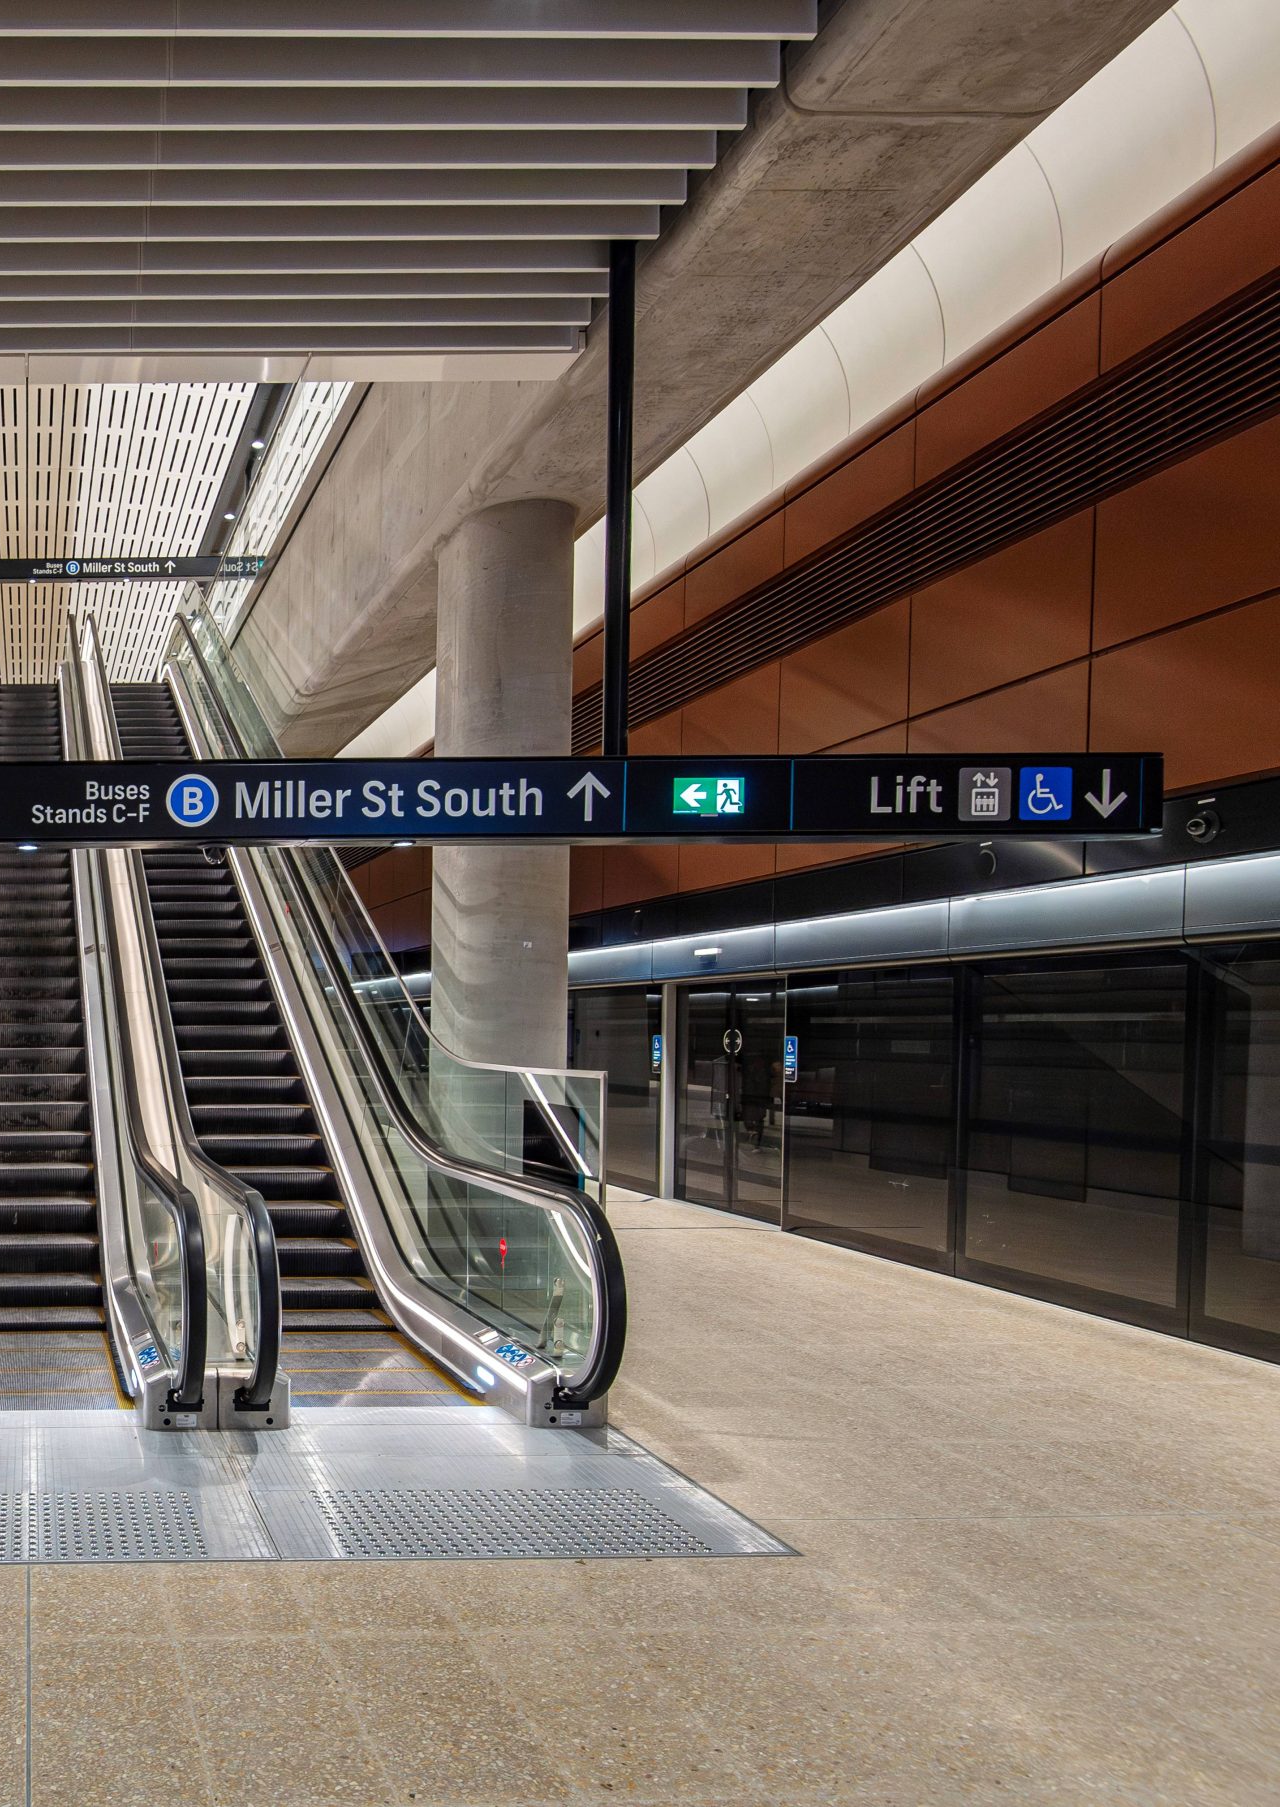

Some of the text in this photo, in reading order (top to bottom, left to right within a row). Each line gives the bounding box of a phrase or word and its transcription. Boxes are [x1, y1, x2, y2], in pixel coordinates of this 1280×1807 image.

[83, 561, 159, 573] Miller St South
[85, 780, 150, 801] Buses
[234, 777, 543, 820] Miller St South
[869, 775, 943, 815] Lift
[31, 803, 150, 824] Stands C-F
